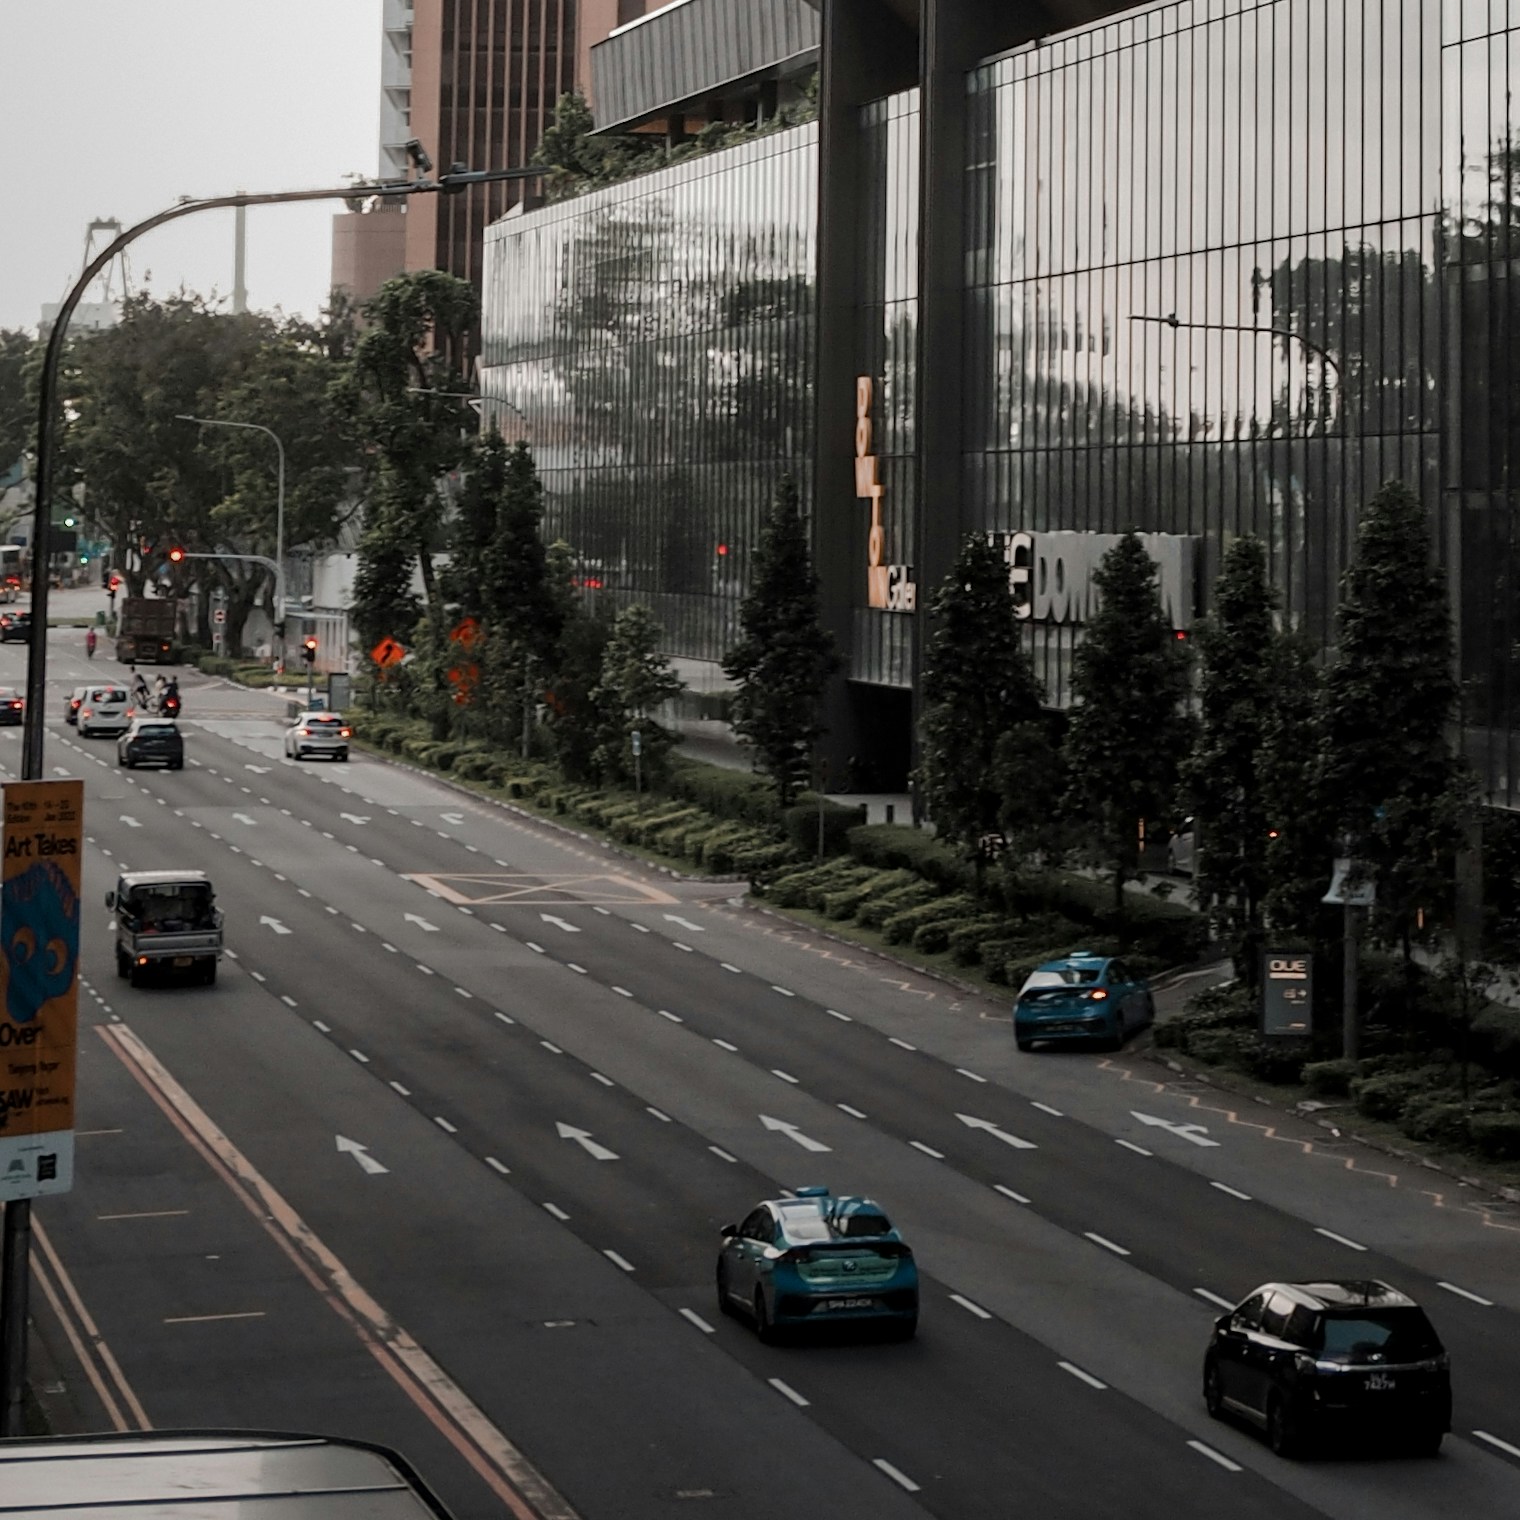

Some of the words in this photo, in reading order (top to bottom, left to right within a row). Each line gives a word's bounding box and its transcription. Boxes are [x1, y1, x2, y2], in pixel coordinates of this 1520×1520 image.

[5, 835, 32, 858] Art
[34, 833, 77, 856] Takes
[0, 1023, 43, 1047] Over
